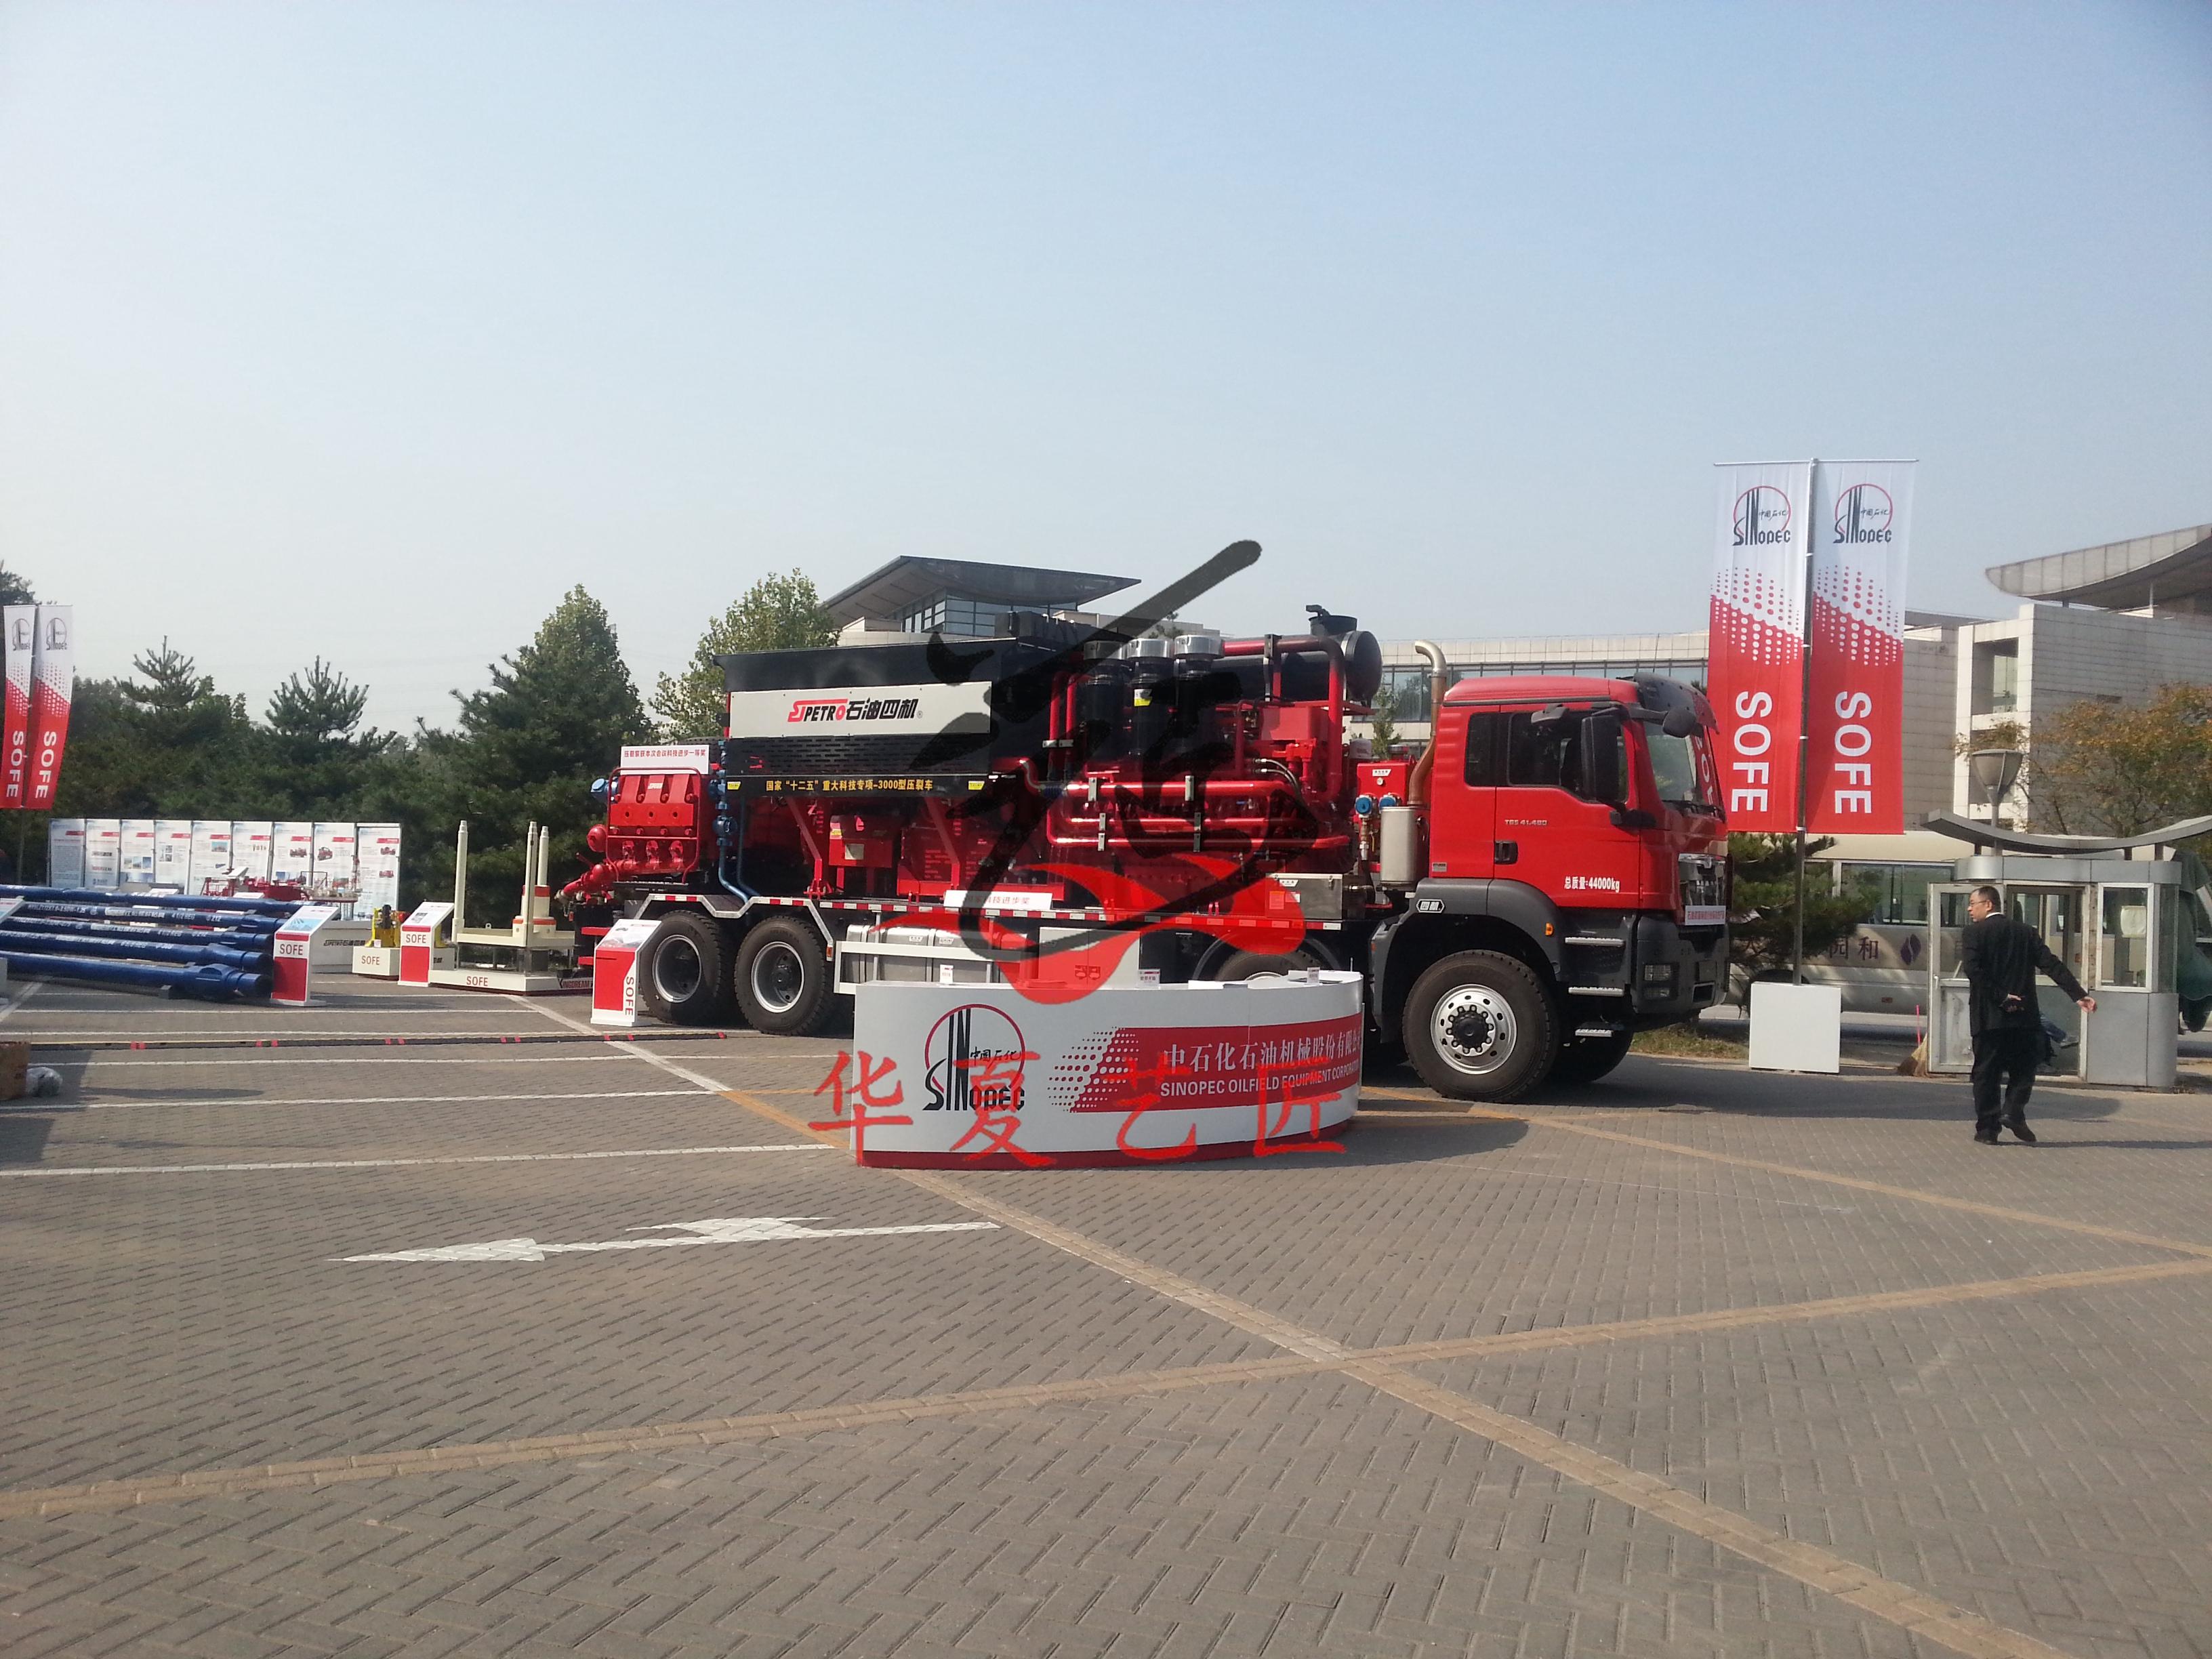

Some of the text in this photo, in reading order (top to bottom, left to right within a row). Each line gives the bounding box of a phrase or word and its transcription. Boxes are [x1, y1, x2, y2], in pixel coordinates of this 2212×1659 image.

[1732, 487, 1791, 546] SINOPEC
[1832, 486, 1892, 544] SINOPEC
[846, 697, 919, 720] 石油四机
[6, 730, 24, 798] SOFE
[35, 731, 57, 799] SOFE
[1731, 690, 1774, 814] SOFE
[1834, 691, 1872, 815] SOFE
[279, 943, 304, 956] SOFE
[361, 955, 380, 966] SOFE
[406, 934, 427, 944] SOFE
[466, 976, 488, 987] SOFE
[625, 977, 634, 1016] SOFE
[922, 1008, 1025, 1111] SINOPEC
[1160, 1080, 1225, 1097] SINOPEC
[1228, 1076, 1279, 1094] OILFIELD
[1282, 1069, 1332, 1089] EQUIPMENT
